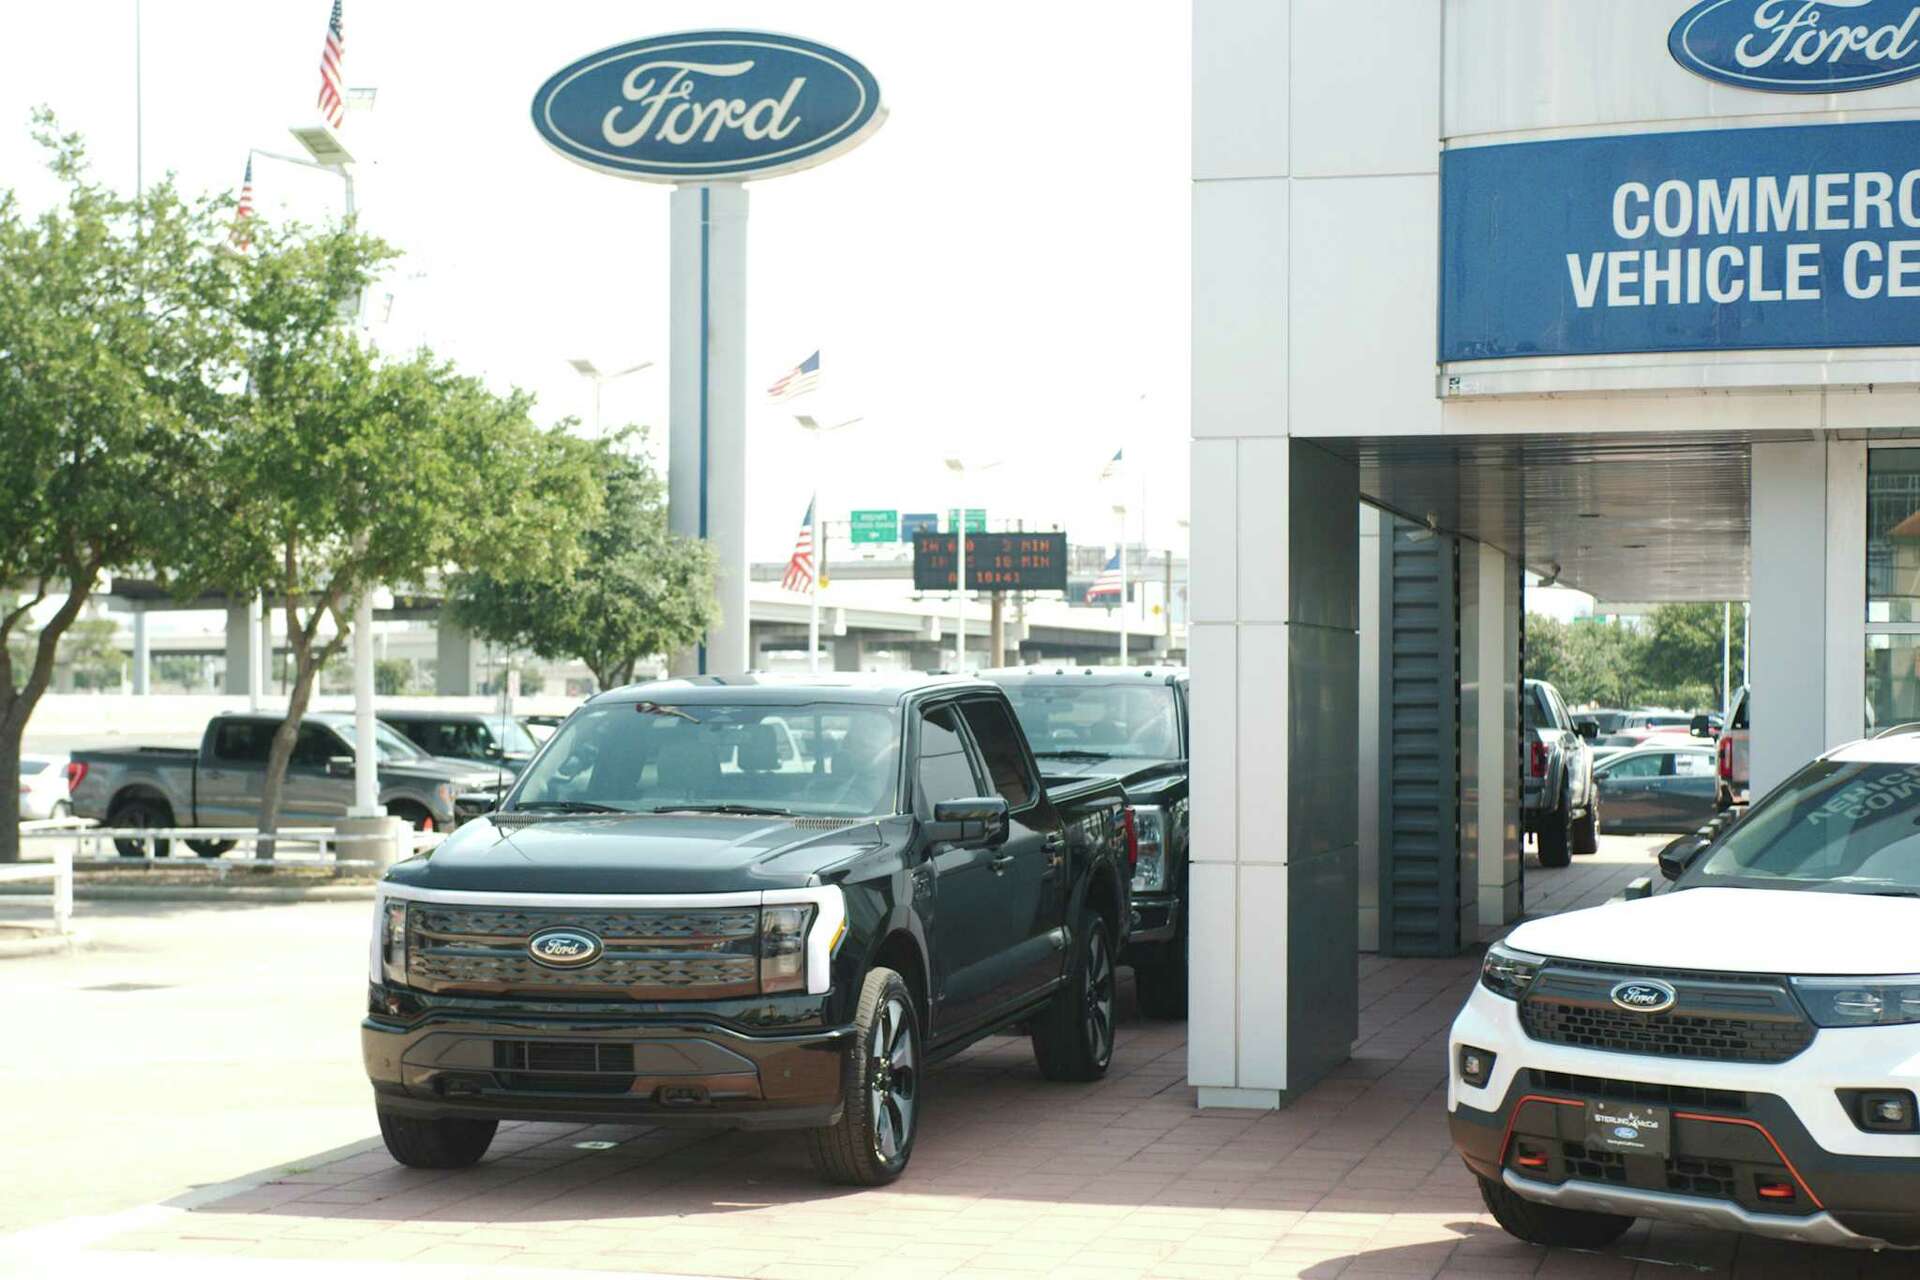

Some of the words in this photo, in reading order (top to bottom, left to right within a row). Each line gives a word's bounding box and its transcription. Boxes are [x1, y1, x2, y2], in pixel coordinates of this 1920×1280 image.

[1735, 0, 1919, 68] Ford
[602, 60, 807, 147] Ford
[1566, 243, 1821, 308] VEHICLE
[545, 939, 580, 955] Ford
[1623, 986, 1659, 1005] Ford
